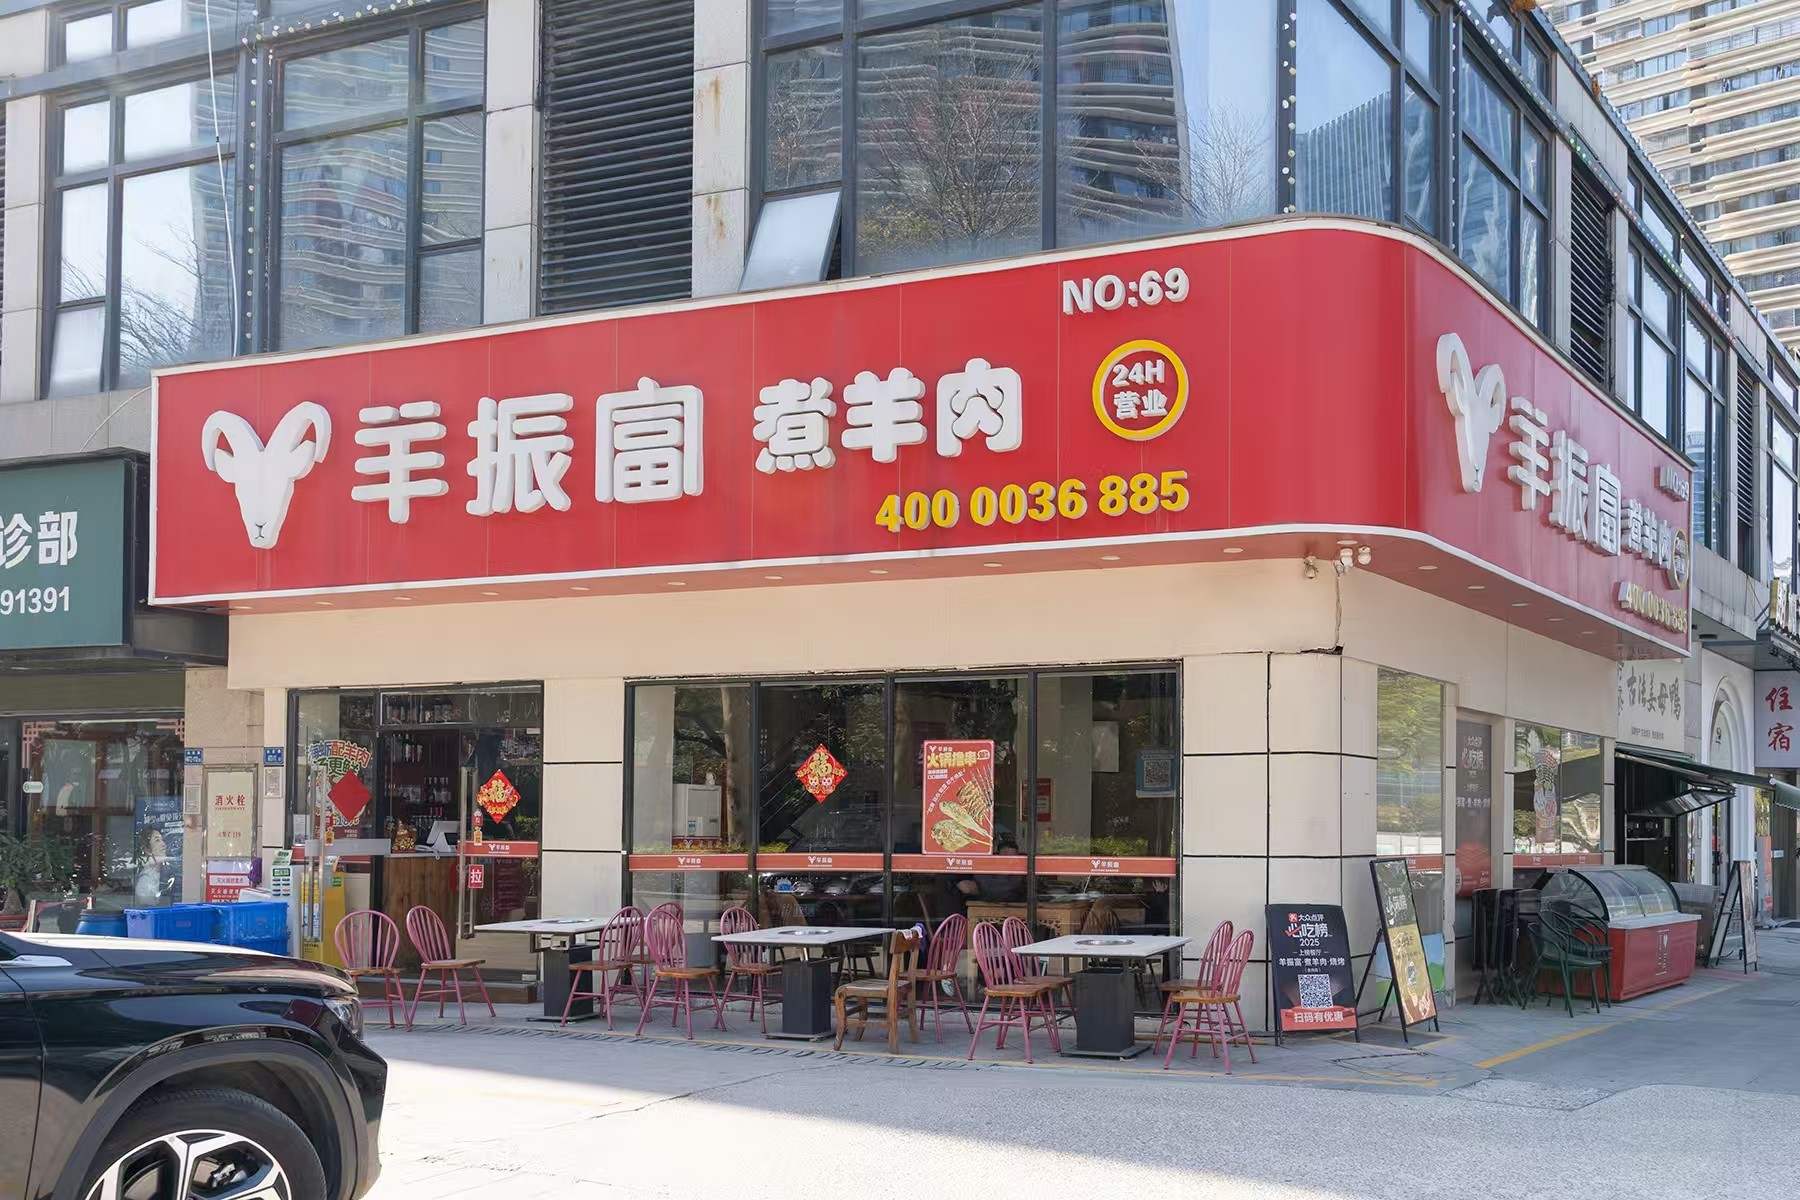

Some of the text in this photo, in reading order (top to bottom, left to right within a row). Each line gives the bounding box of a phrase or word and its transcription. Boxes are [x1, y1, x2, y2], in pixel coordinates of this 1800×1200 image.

[1062, 267, 1190, 315] NO:69
[1111, 359, 1166, 388] 24H
[1112, 387, 1169, 420] 营业
[351, 357, 1023, 525] 羊振富 煮羊肉
[1507, 396, 1622, 556] 羊振富
[875, 470, 1191, 533] 400 0036 885
[0, 586, 70, 616] 91391
[1765, 686, 1793, 752] 住宿
[215, 795, 246, 806] 消火栓
[470, 868, 483, 884] 拉
[1286, 922, 1329, 938] 必吃榜
[1298, 914, 1325, 922] 大众点评
[1300, 938, 1320, 947] 2025
[1293, 1010, 1345, 1024] 扫码有优惠
